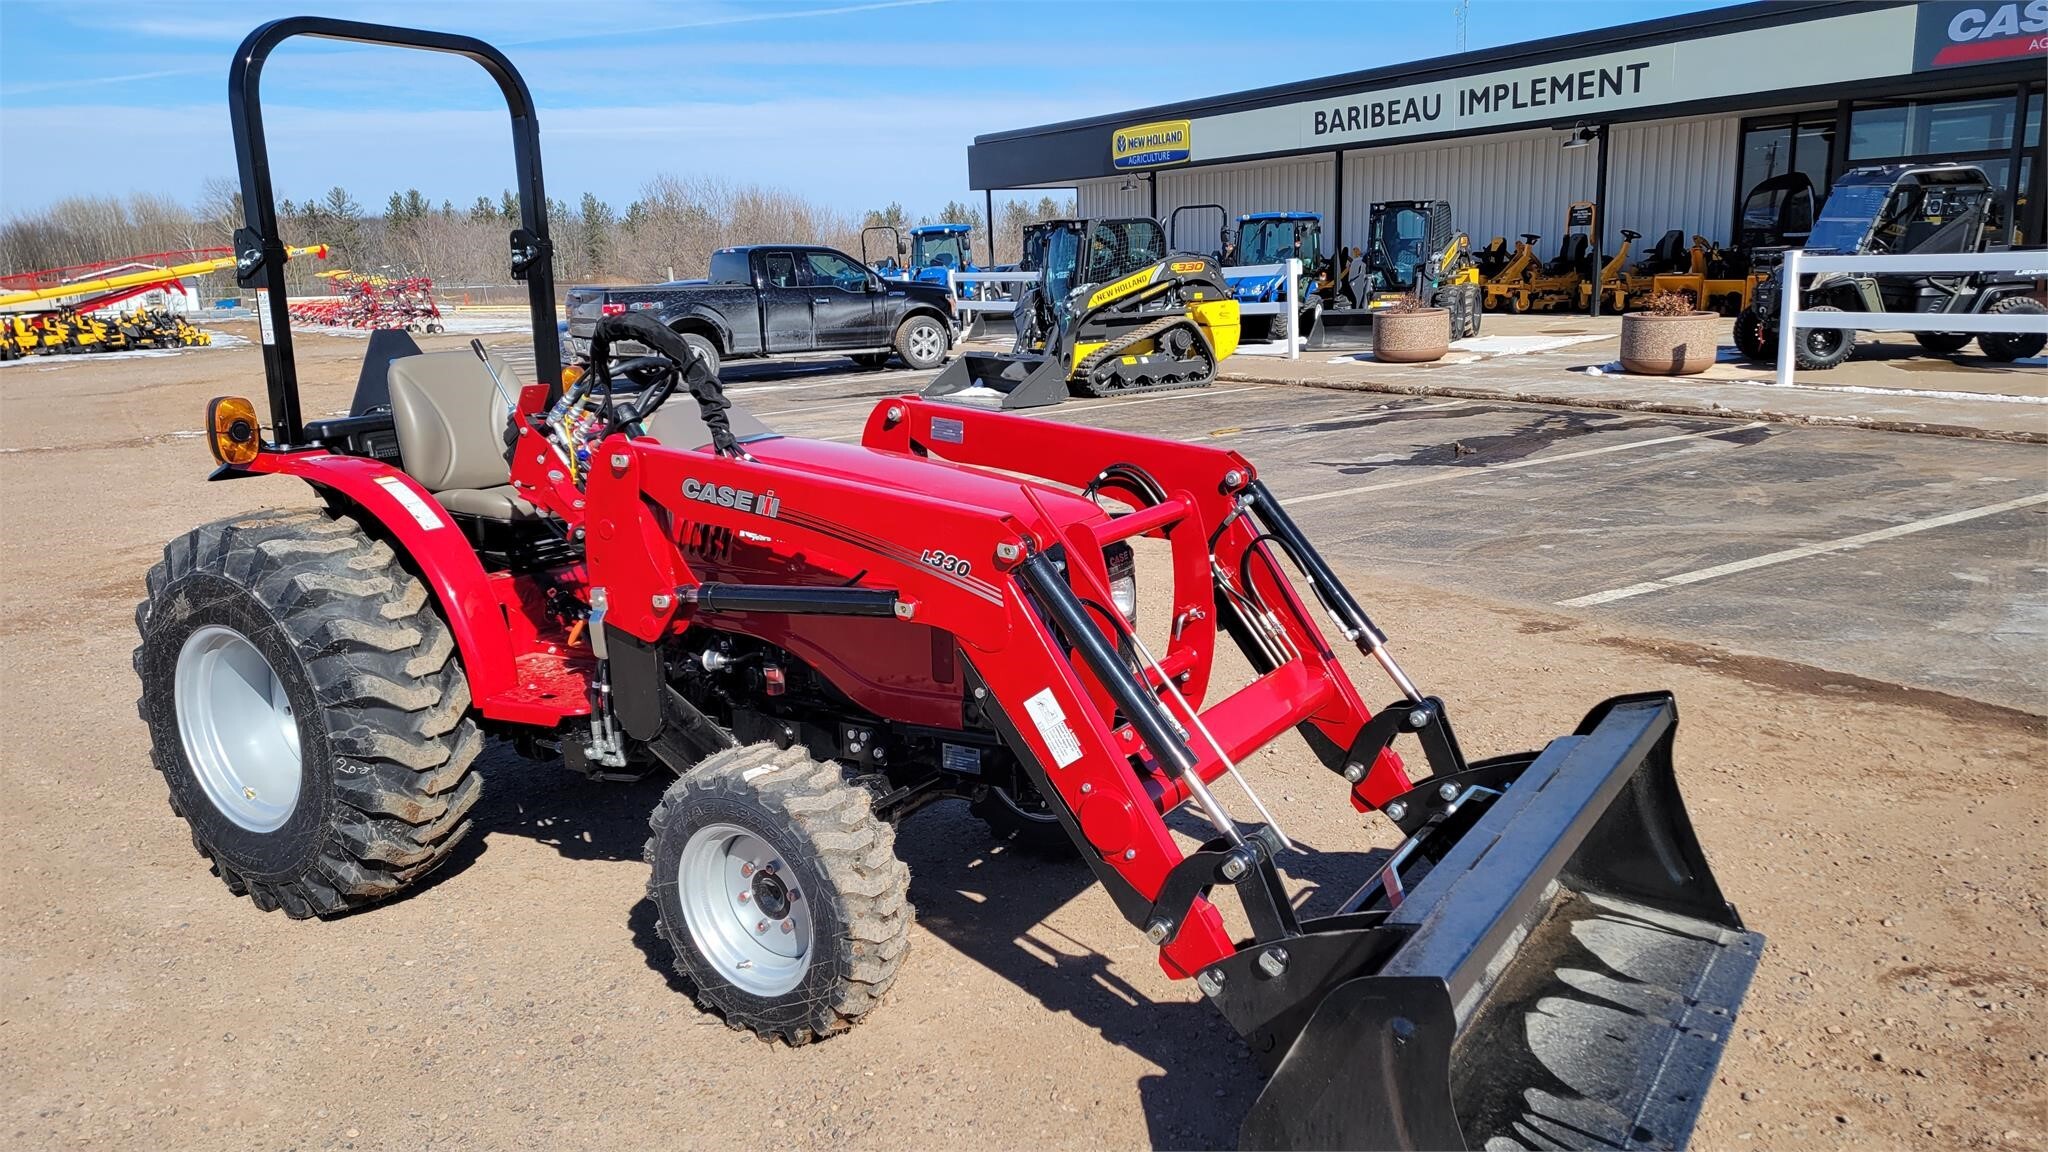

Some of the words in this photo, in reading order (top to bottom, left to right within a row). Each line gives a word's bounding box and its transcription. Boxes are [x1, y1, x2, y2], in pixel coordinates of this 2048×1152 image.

[1314, 93, 1442, 135] BARIBEAU
[1459, 61, 1650, 117] IMPLEMENT
[1128, 136, 1146, 149] NEW
[1147, 130, 1183, 147] HOLLAND
[1128, 151, 1170, 165] AGRICULTURE
[1096, 288, 1115, 302] NEW
[1115, 274, 1148, 295] HOLLAND
[682, 478, 754, 512] CASE
[921, 549, 971, 577] L330
